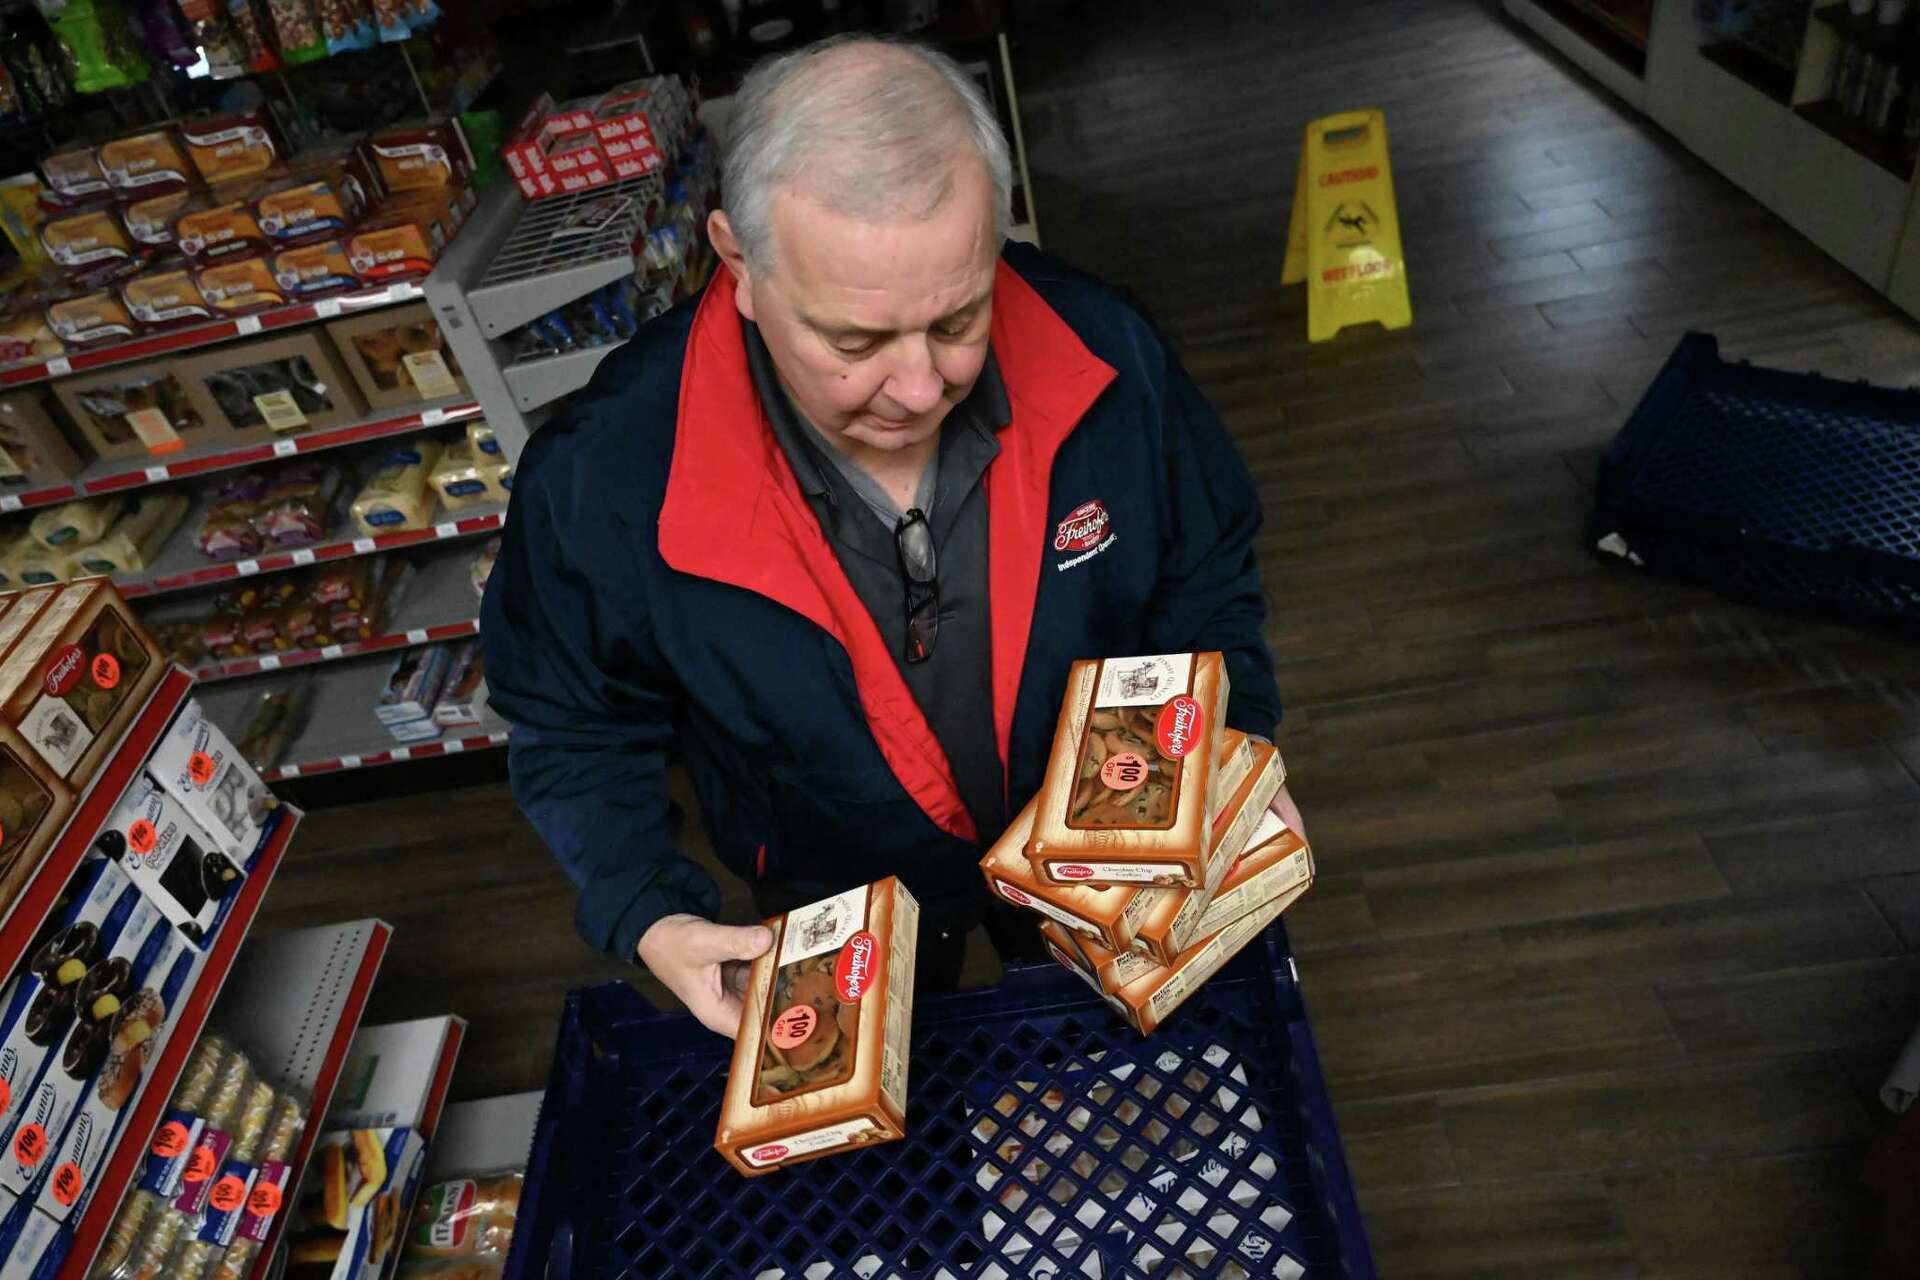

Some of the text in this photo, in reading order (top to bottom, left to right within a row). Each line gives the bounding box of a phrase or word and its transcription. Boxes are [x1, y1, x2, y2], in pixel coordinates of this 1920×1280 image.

[1167, 698, 1196, 755] Freihofer's
[1104, 761, 1116, 778] OFF
[846, 936, 871, 997] Freihofer's
